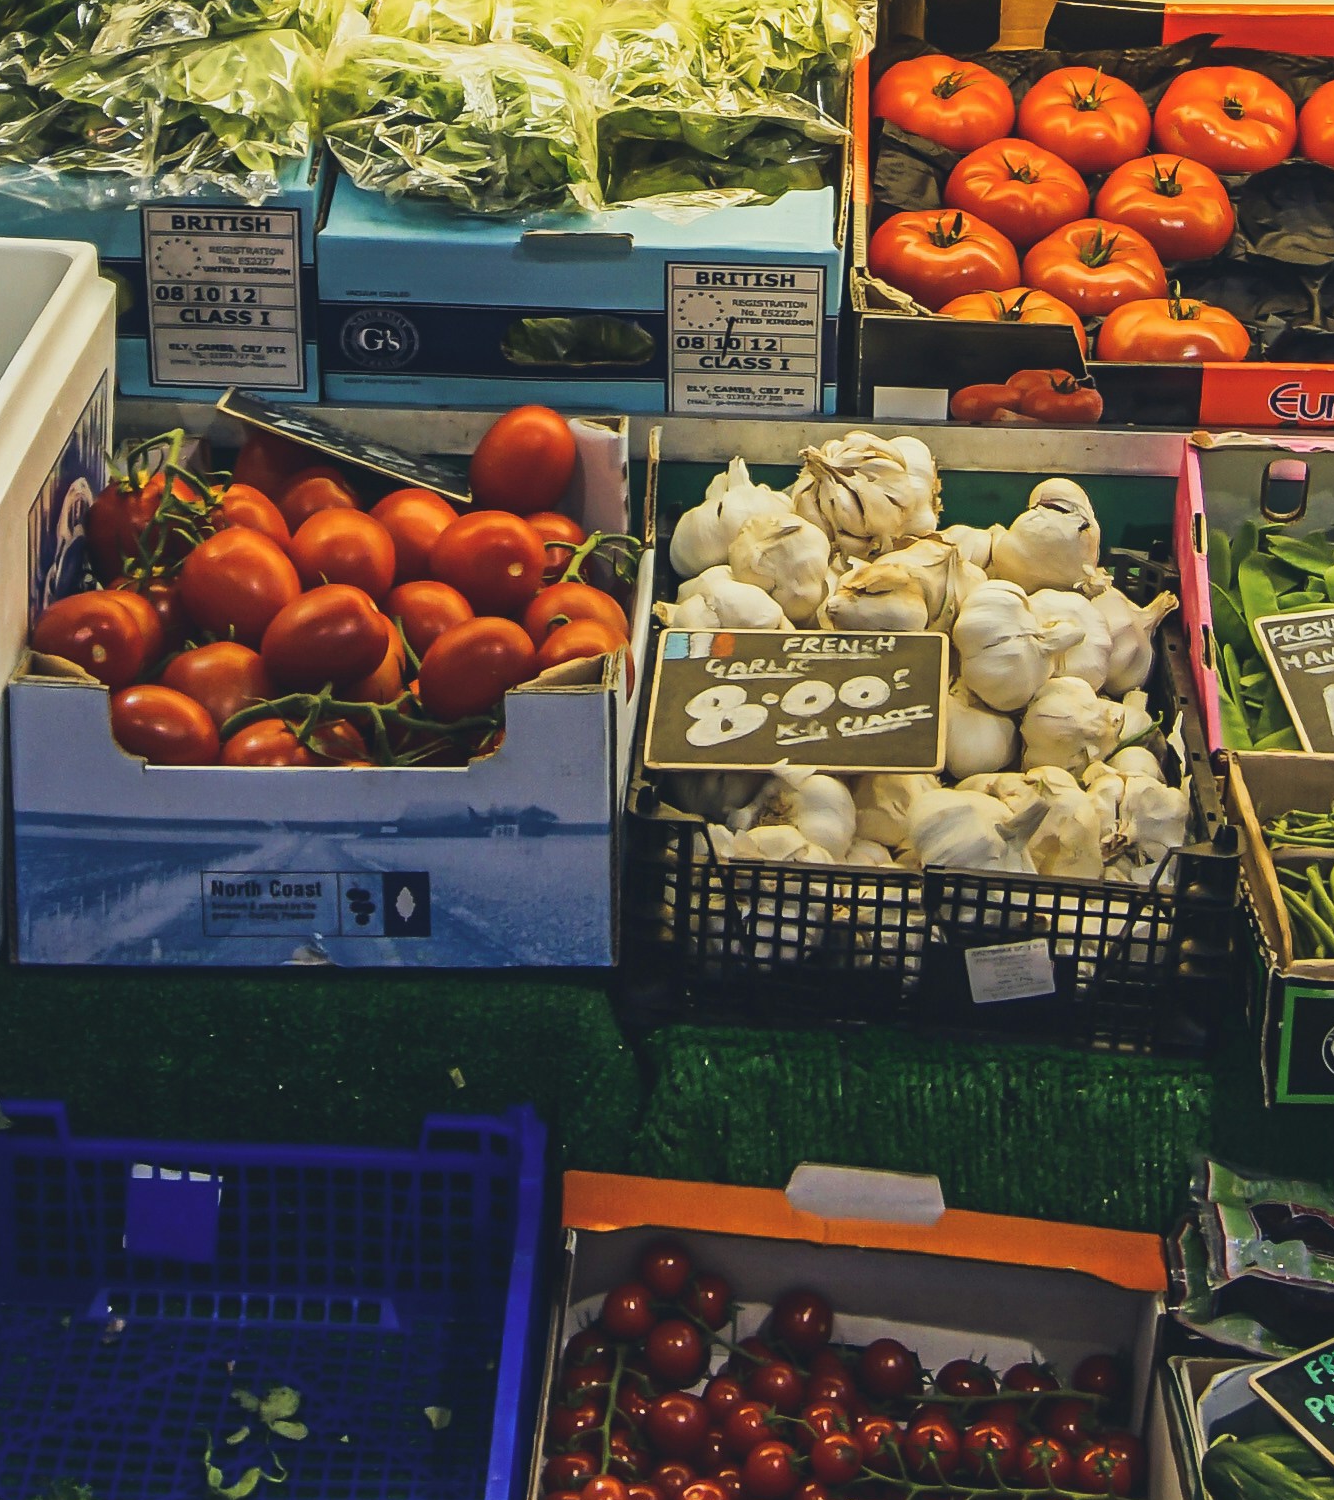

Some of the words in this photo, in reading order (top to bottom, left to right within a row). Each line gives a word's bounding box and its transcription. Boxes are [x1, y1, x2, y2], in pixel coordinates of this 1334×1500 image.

[171, 215, 270, 232] BRITISH
[695, 271, 795, 288] BRITISH
[155, 286, 184, 301] 08
[193, 287, 220, 301] 10
[230, 288, 255, 303] 12
[732, 299, 807, 308] REGISTRATION
[179, 309, 252, 324] CLASS
[359, 328, 400, 351] G's
[677, 336, 704, 349] 08
[750, 339, 777, 351] 12
[699, 356, 771, 370] CLASS
[782, 636, 896, 653] FRENCH
[705, 659, 815, 675] GARLIC
[211, 880, 261, 898] North
[270, 880, 322, 898] Coast
